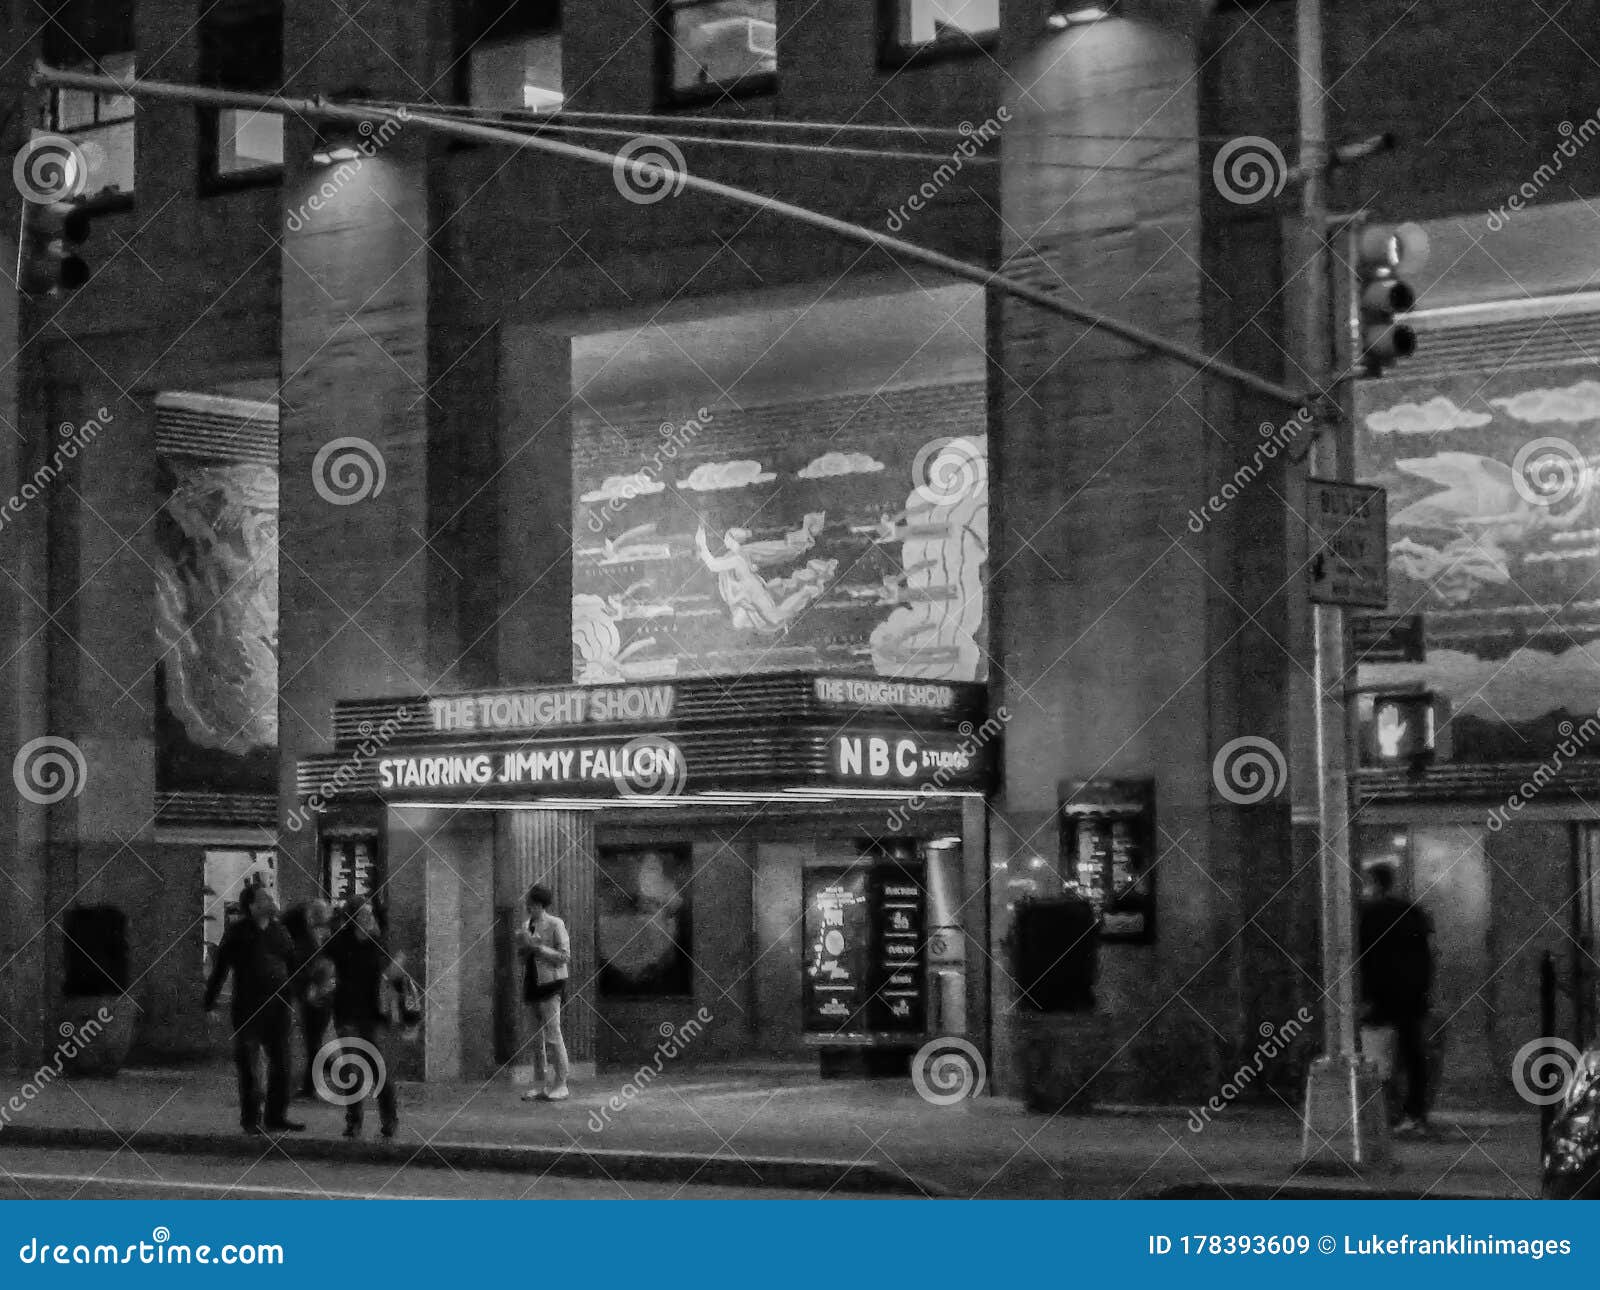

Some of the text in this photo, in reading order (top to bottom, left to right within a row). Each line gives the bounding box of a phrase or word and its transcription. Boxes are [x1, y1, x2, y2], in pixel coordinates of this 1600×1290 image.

[430, 685, 675, 731] THE TONIGHT SHOW
[815, 677, 953, 708] THE TONIGHT SHOW
[379, 746, 676, 788] STARRING JIMMY FALLON
[840, 737, 918, 777] NBC
